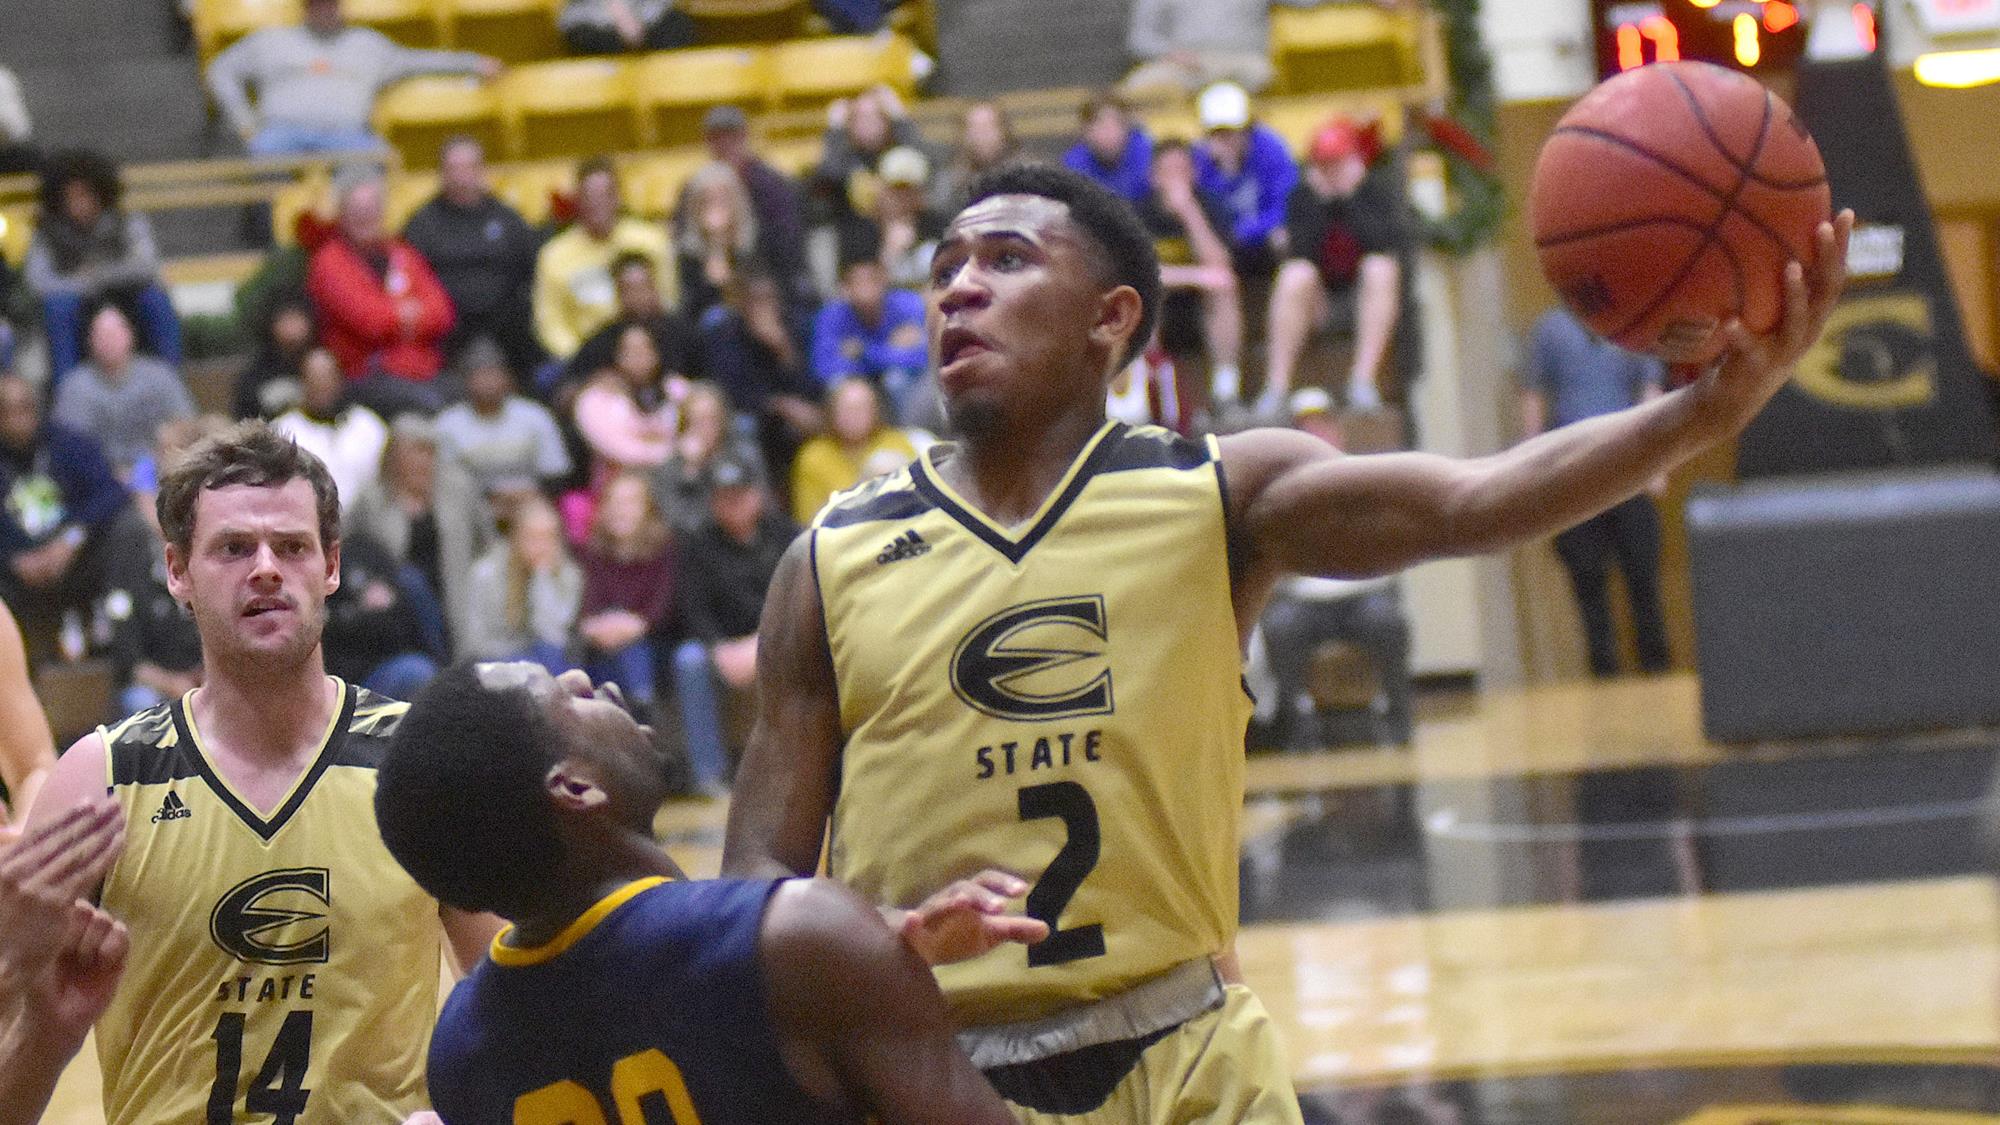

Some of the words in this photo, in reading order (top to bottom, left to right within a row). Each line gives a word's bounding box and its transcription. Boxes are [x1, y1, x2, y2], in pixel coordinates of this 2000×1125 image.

[976, 730, 1102, 780] STATE
[1017, 781, 1106, 968] 2
[216, 974, 316, 1003] STATE
[206, 1010, 313, 1125] 14
